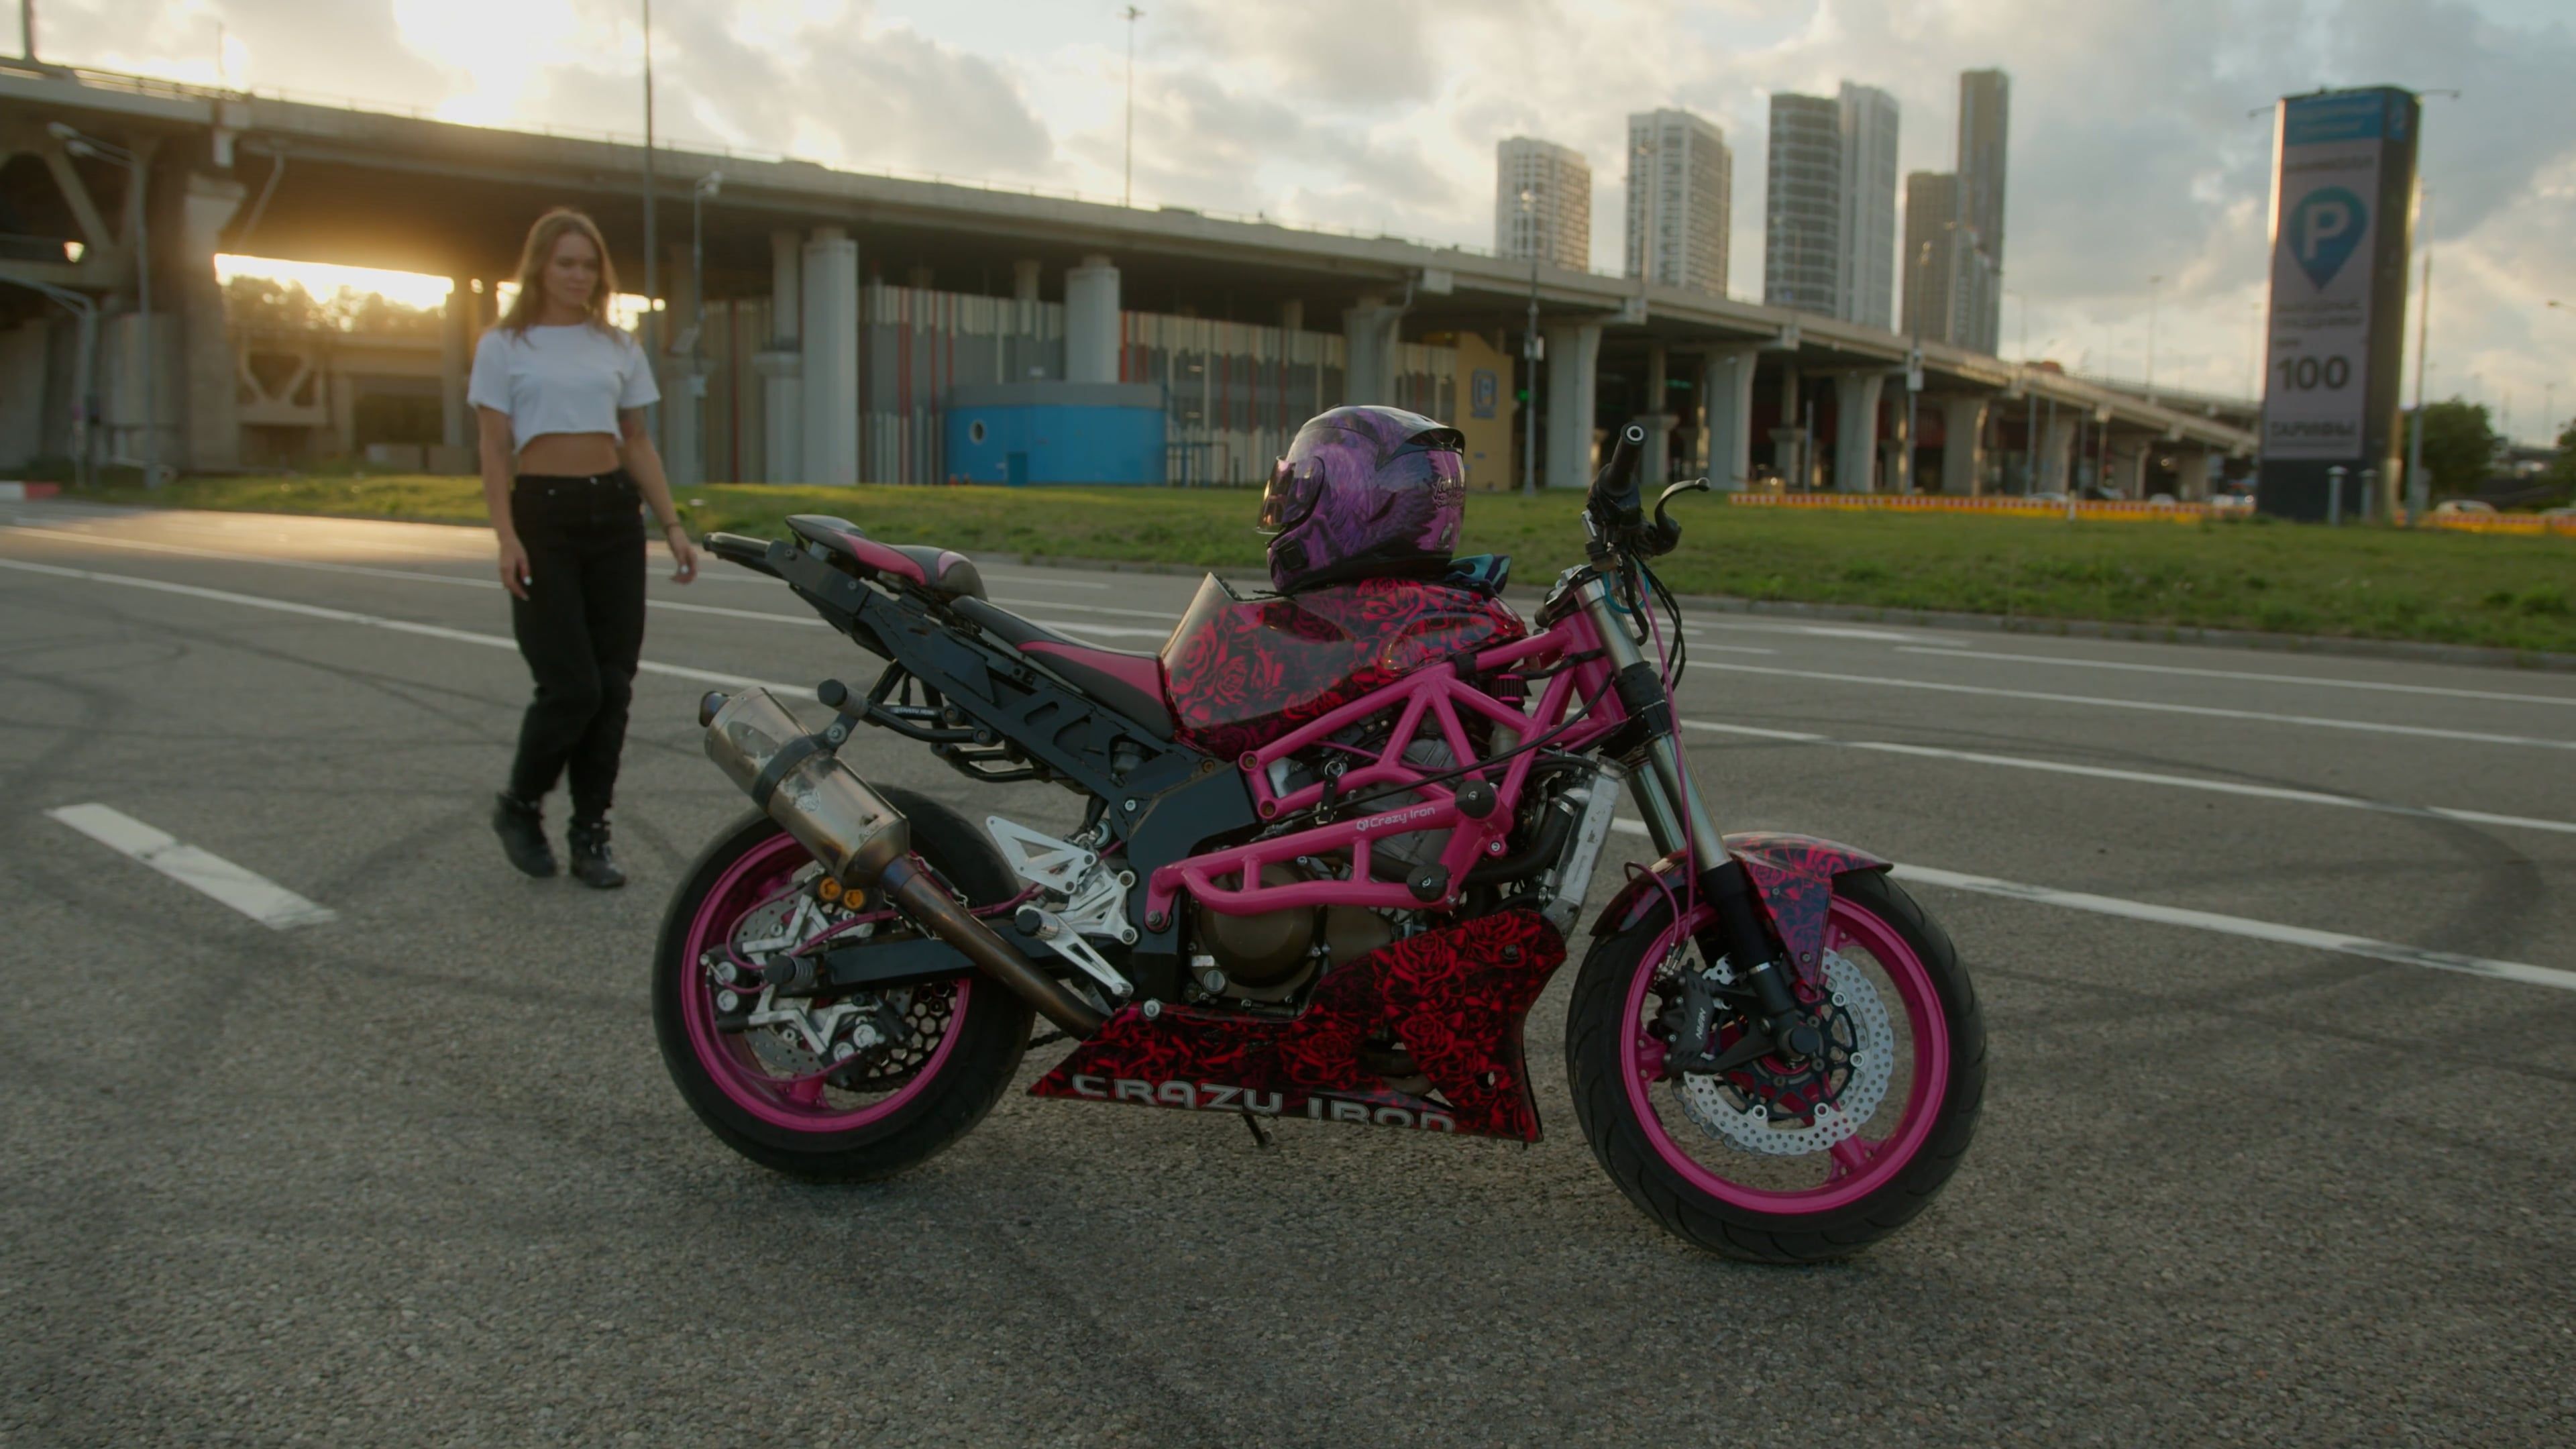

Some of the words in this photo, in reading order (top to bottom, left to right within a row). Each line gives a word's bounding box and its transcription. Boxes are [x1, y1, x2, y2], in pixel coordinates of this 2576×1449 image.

[2275, 355, 2350, 390] 100
[1370, 813, 1407, 827] Crazy
[1409, 807, 1435, 819] Iron
[1072, 1074, 1283, 1115] CRAZY
[1308, 1095, 1456, 1132] IRON
